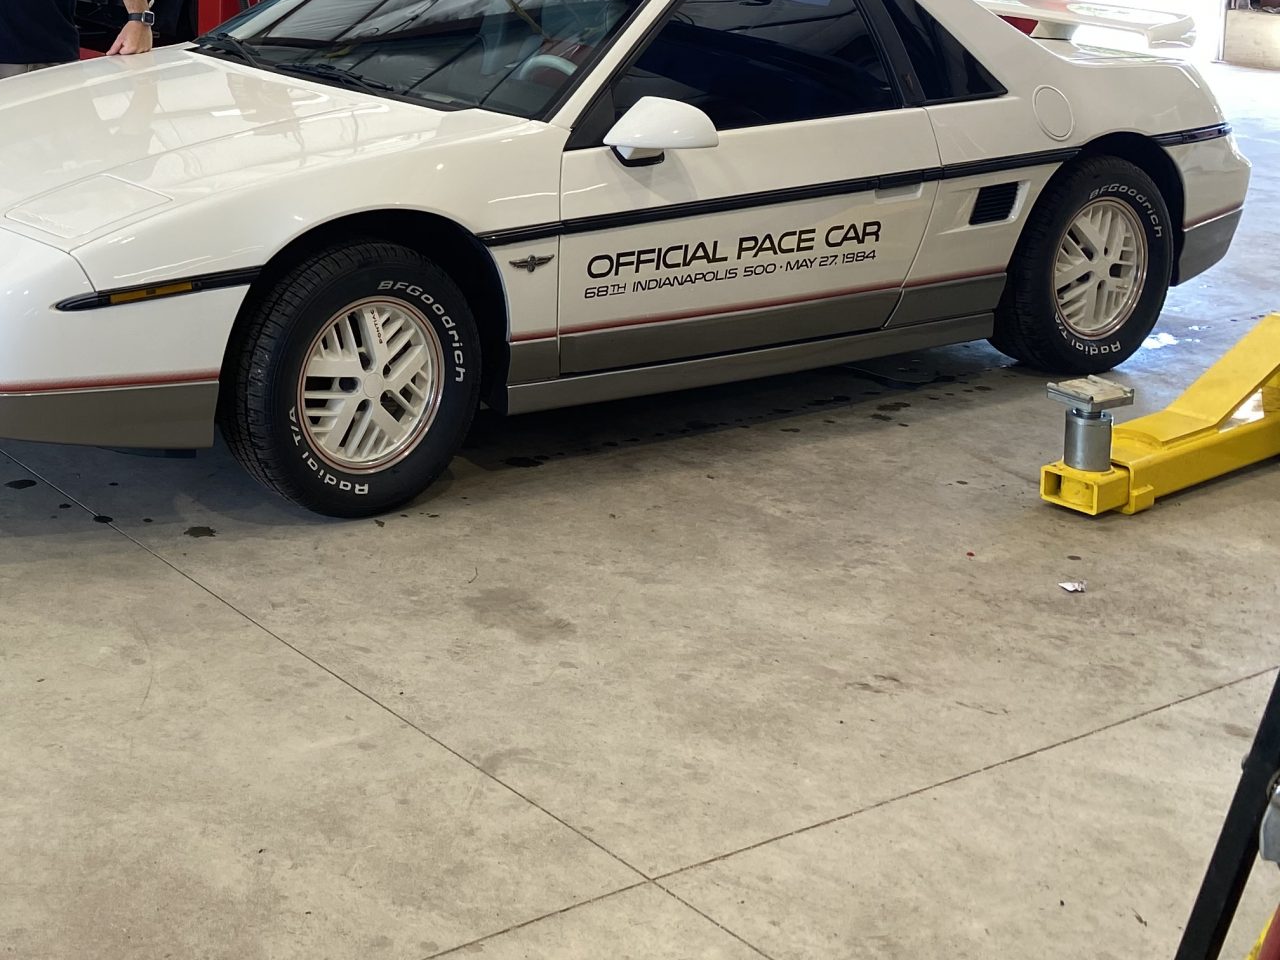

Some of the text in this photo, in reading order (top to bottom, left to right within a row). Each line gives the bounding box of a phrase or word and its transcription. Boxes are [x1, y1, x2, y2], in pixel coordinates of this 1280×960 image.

[1089, 183, 1162, 238] BFGoodrich
[586, 220, 882, 279] OFFICIAL PACE CAR
[632, 268, 738, 293] INDIANAPOLIS
[743, 263, 777, 278] 500
[785, 256, 818, 272] MAY
[841, 249, 877, 264] 1984
[377, 280, 466, 382] BFGoodrich
[1071, 339, 1122, 356] Radial
[302, 451, 369, 495] Radial
